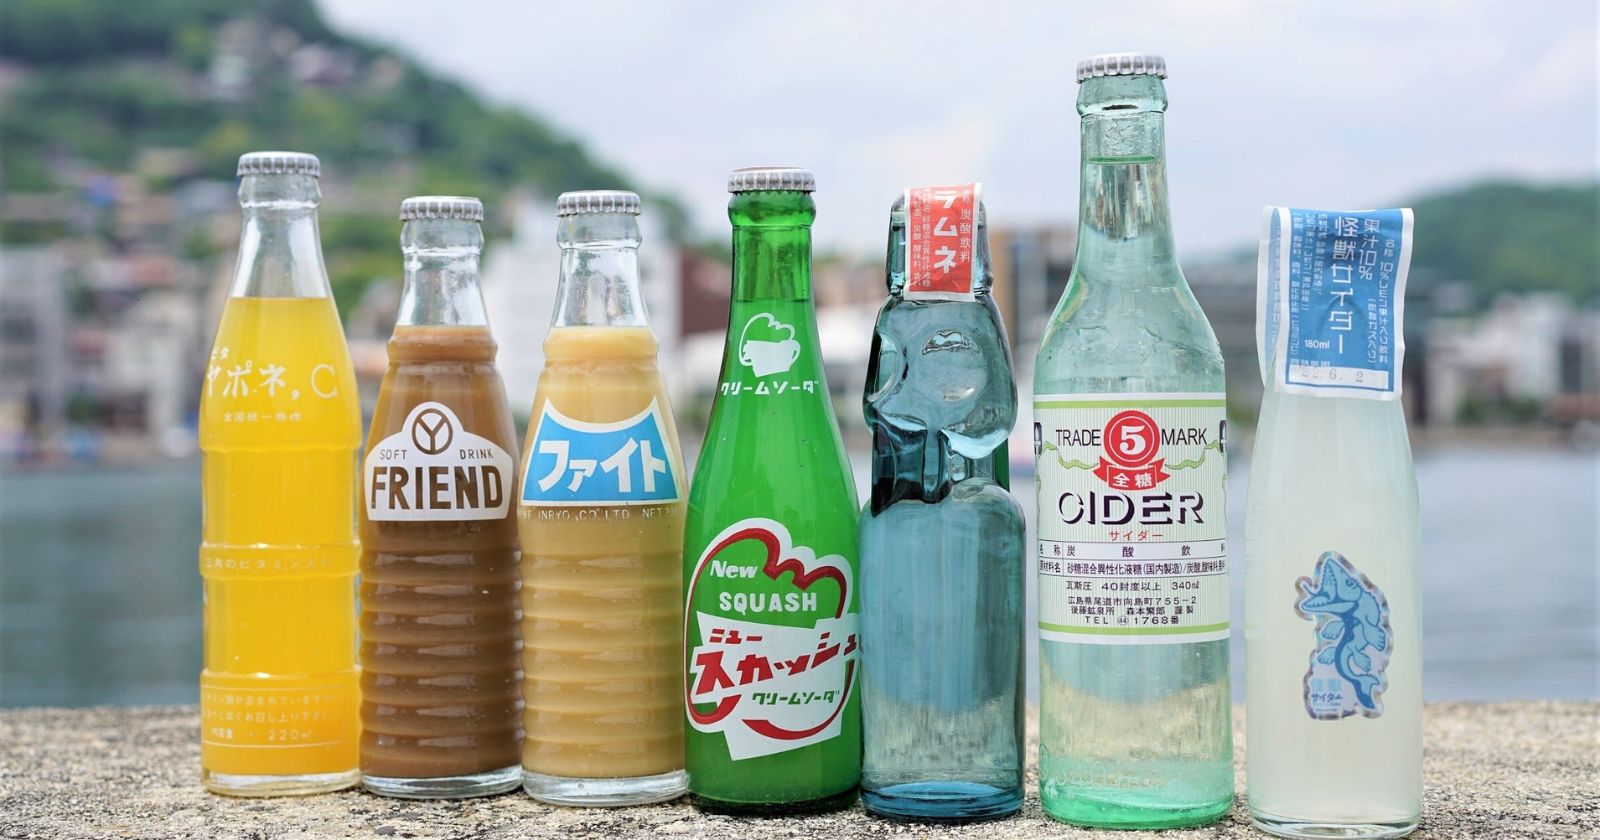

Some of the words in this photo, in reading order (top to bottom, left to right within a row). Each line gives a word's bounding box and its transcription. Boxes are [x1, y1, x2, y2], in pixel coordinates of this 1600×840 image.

[933, 190, 959, 275] ラムネ
[1358, 218, 1381, 281] 果汁10%
[1330, 215, 1359, 355] 怪獣サイダー
[1304, 339, 1330, 350] 180ml
[721, 380, 819, 396] クリームソーダ
[1056, 429, 1100, 446] TRADE
[1119, 425, 1146, 455] 5
[1161, 428, 1207, 446] MARK
[380, 449, 407, 460] SOFT
[459, 449, 494, 460] DRINK
[538, 437, 666, 493] ファイト
[371, 466, 503, 510] FRIEND
[1113, 473, 1153, 488] 全糖
[1059, 490, 1204, 525] CIDER
[1109, 530, 1163, 542] サイダー
[709, 560, 758, 579] New
[719, 592, 817, 615] SQUASH
[1085, 616, 1109, 625] TEL
[709, 628, 763, 645] ニュー
[752, 690, 841, 706] クリームソーダ
